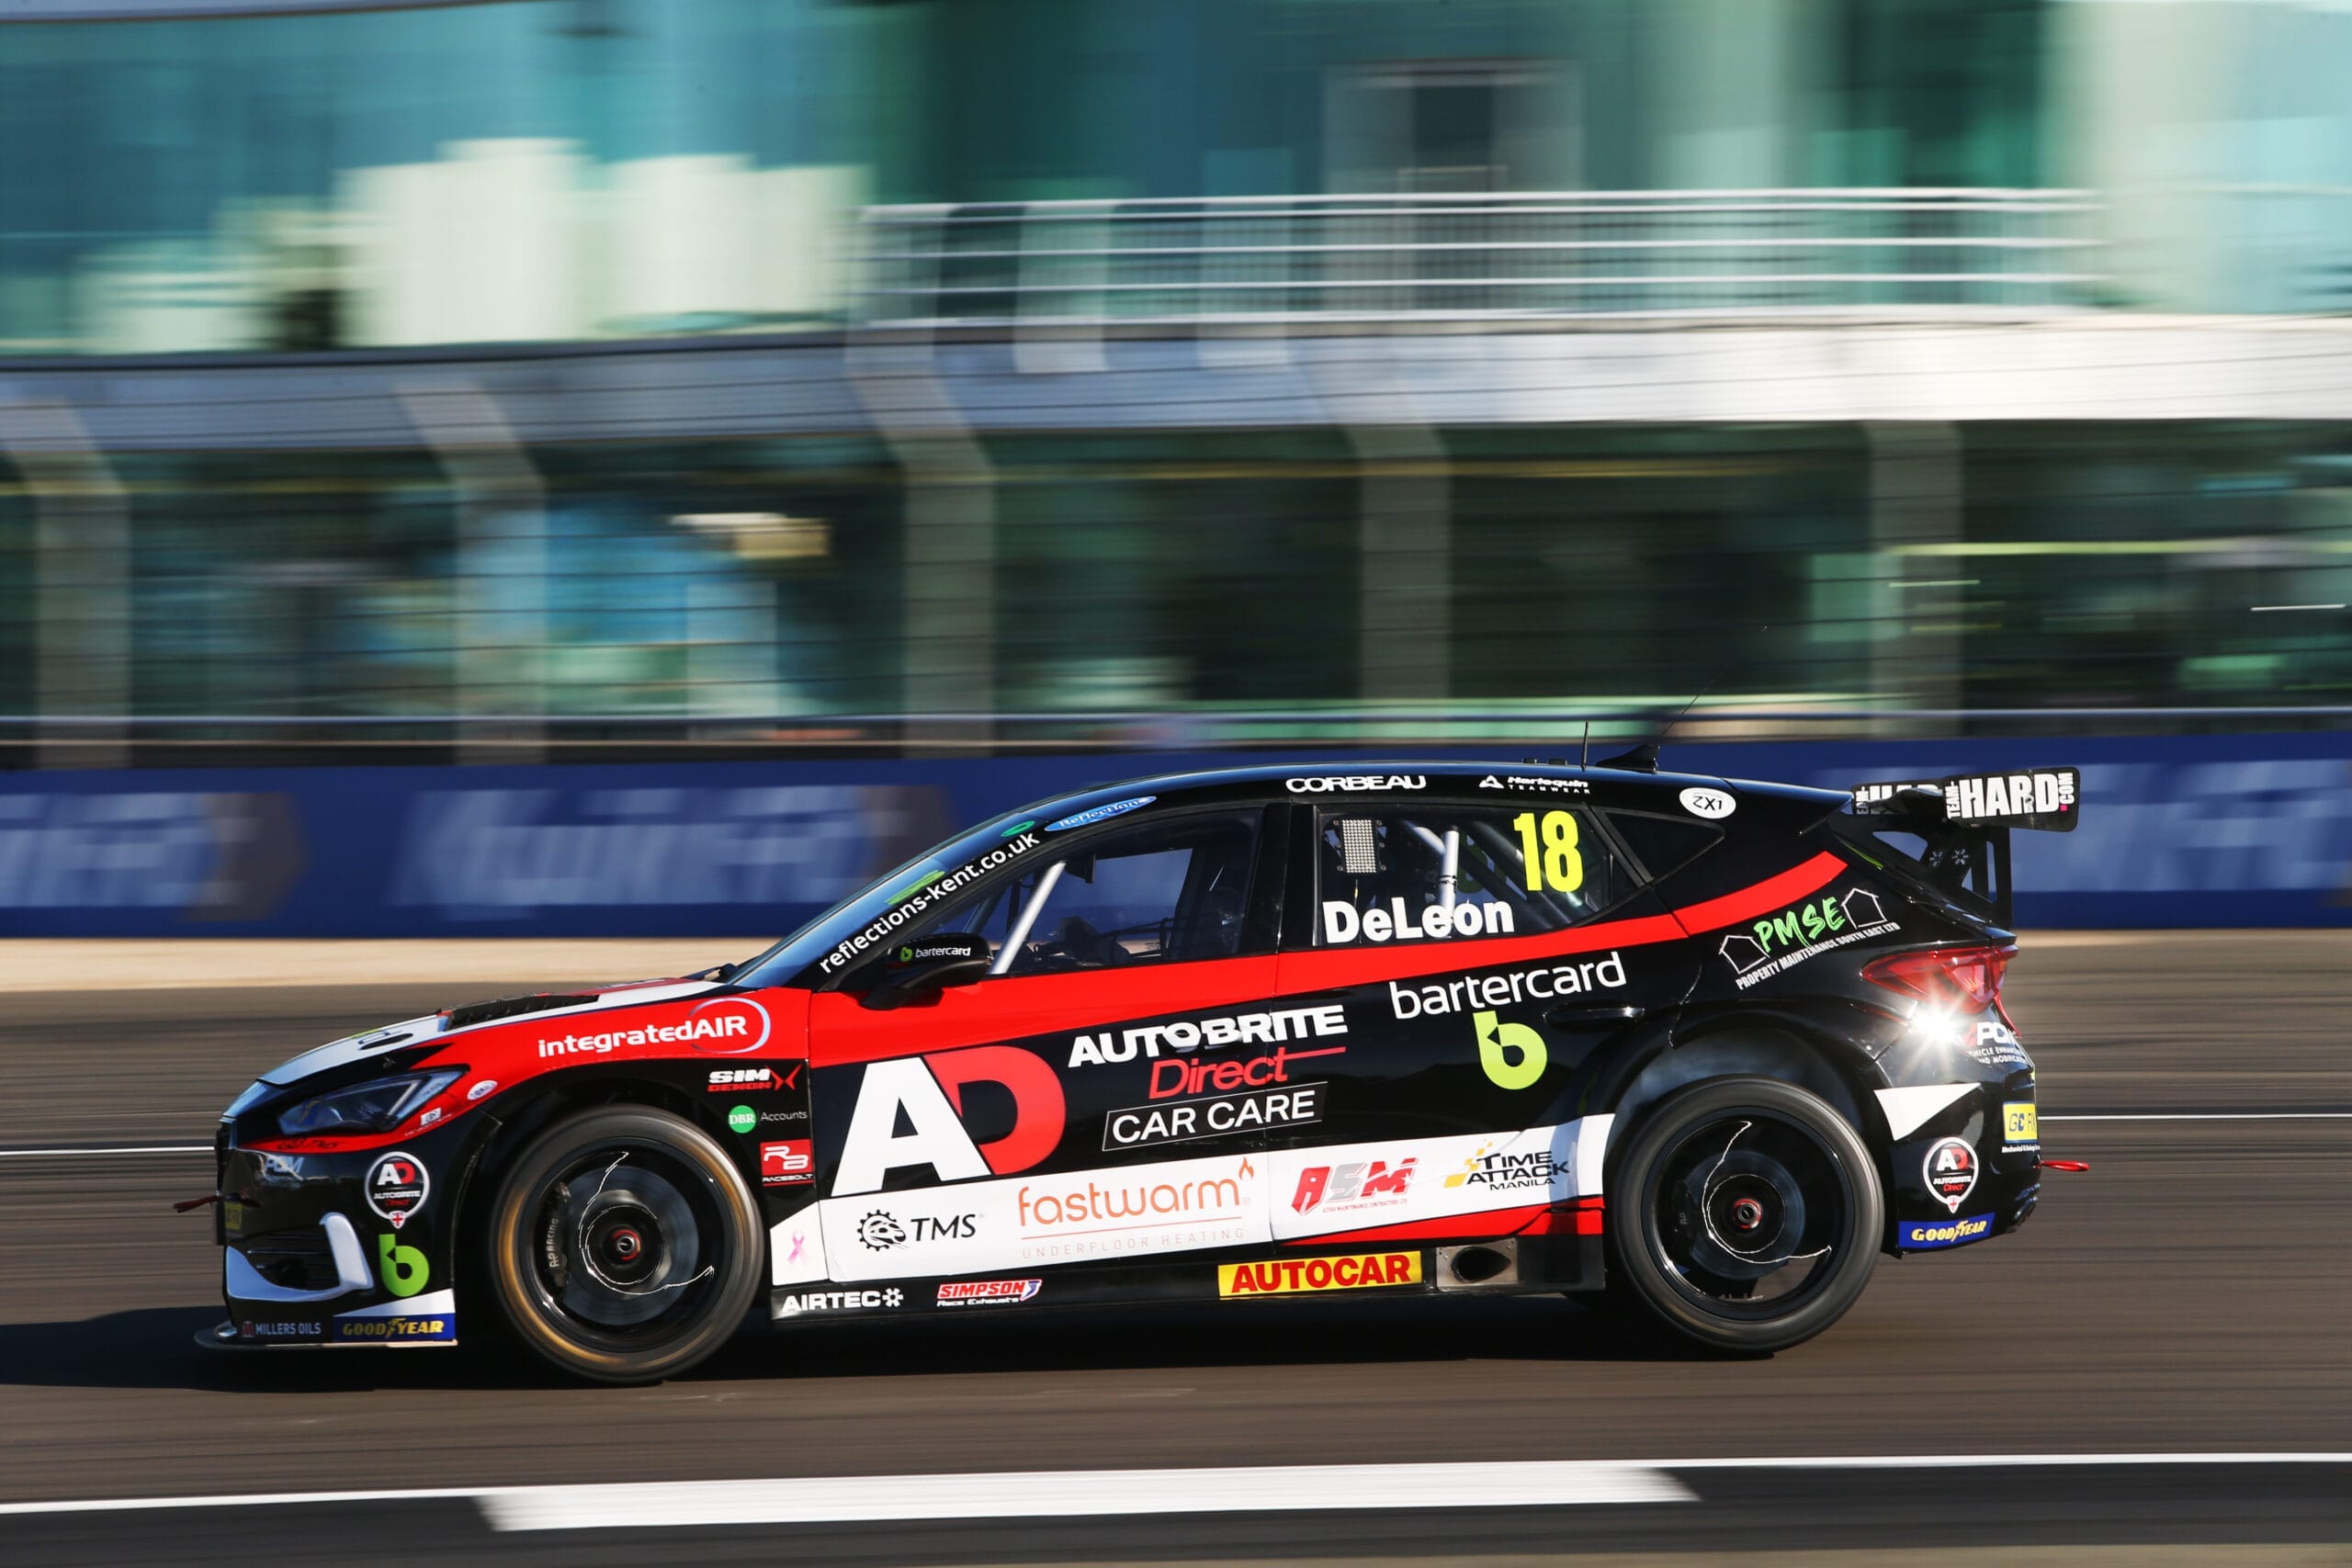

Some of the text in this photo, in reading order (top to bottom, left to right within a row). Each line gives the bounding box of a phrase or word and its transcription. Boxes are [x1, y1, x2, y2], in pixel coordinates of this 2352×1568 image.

[1286, 775, 1426, 793] CORBEAU
[1508, 776, 1589, 788] Harlequin
[1509, 784, 1590, 794] TEAMWEAR
[1959, 773, 2060, 818] HARD
[1513, 810, 1583, 892] 18
[820, 832, 1040, 974] reflections-kent.co.uk
[1322, 897, 1514, 943] DeLeon
[1754, 897, 1846, 953] PMSE
[915, 947, 971, 957] bartercard
[1736, 921, 1901, 990] PROPERTY MAINTENANCE SOUTH EAST LTD
[1389, 951, 1627, 1020] bartercard
[538, 1016, 748, 1057] integratedAIR
[1068, 1004, 1348, 1068] AUTOBRITE
[1148, 1046, 1289, 1100] Direct
[729, 1111, 808, 1125] DBR Accounts
[831, 1044, 1066, 1197] AD
[1112, 1090, 1316, 1144] CAR CARE
[377, 1162, 416, 1185] AD
[1467, 1161, 1570, 1185] ATTACK
[1476, 1151, 1554, 1169] TIME
[1936, 1148, 1969, 1171] AD
[1489, 1178, 1556, 1190] MANILA
[1018, 1179, 1240, 1226] fastwarm
[910, 1214, 977, 1241] TMS
[1022, 1227, 1245, 1259] UNDERFLOOR HEATING
[939, 1281, 1025, 1298] SIMPSON
[1231, 1255, 1411, 1293] AUTOCAR
[782, 1291, 881, 1313] AIRTEC
[255, 1323, 321, 1335] MILLERS OILS
